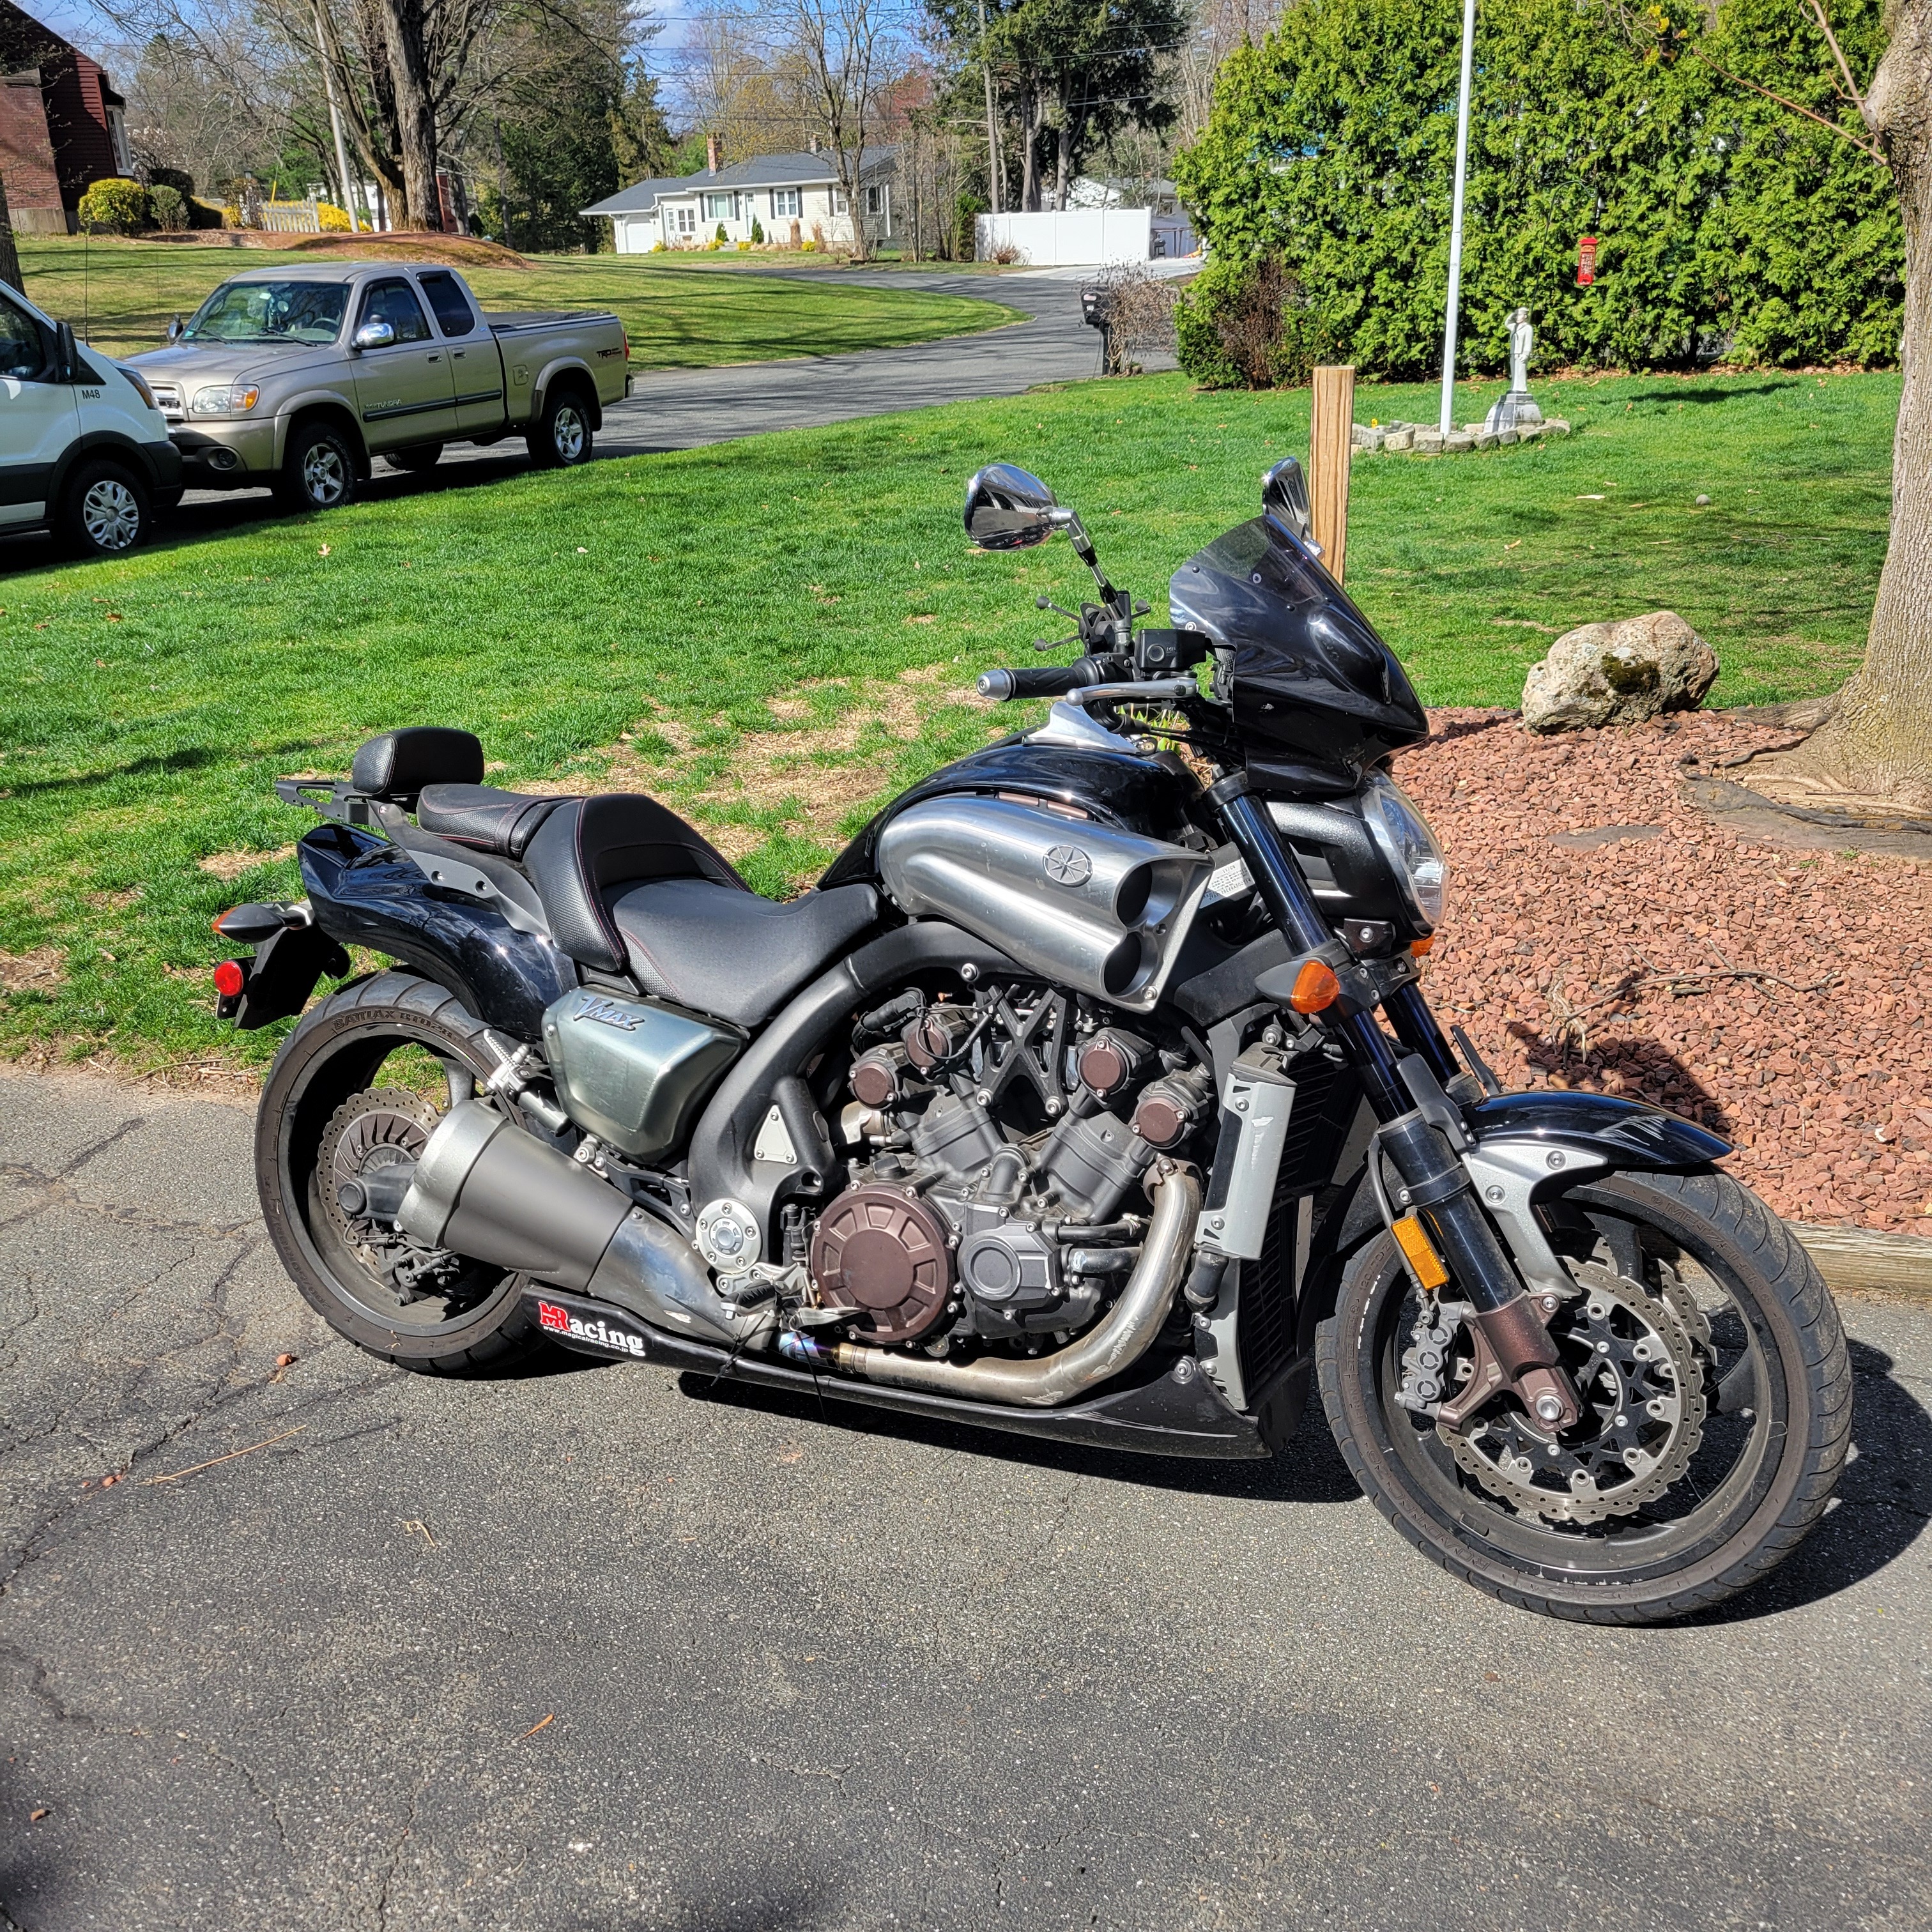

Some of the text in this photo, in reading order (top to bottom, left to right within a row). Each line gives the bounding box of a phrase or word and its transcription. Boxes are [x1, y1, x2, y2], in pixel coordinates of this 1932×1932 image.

[597, 349, 611, 359] TRD
[82, 389, 100, 399] M48
[332, 1009, 395, 1030] BATTLAX
[542, 1324, 629, 1353] www.magicalracing.co.jp
